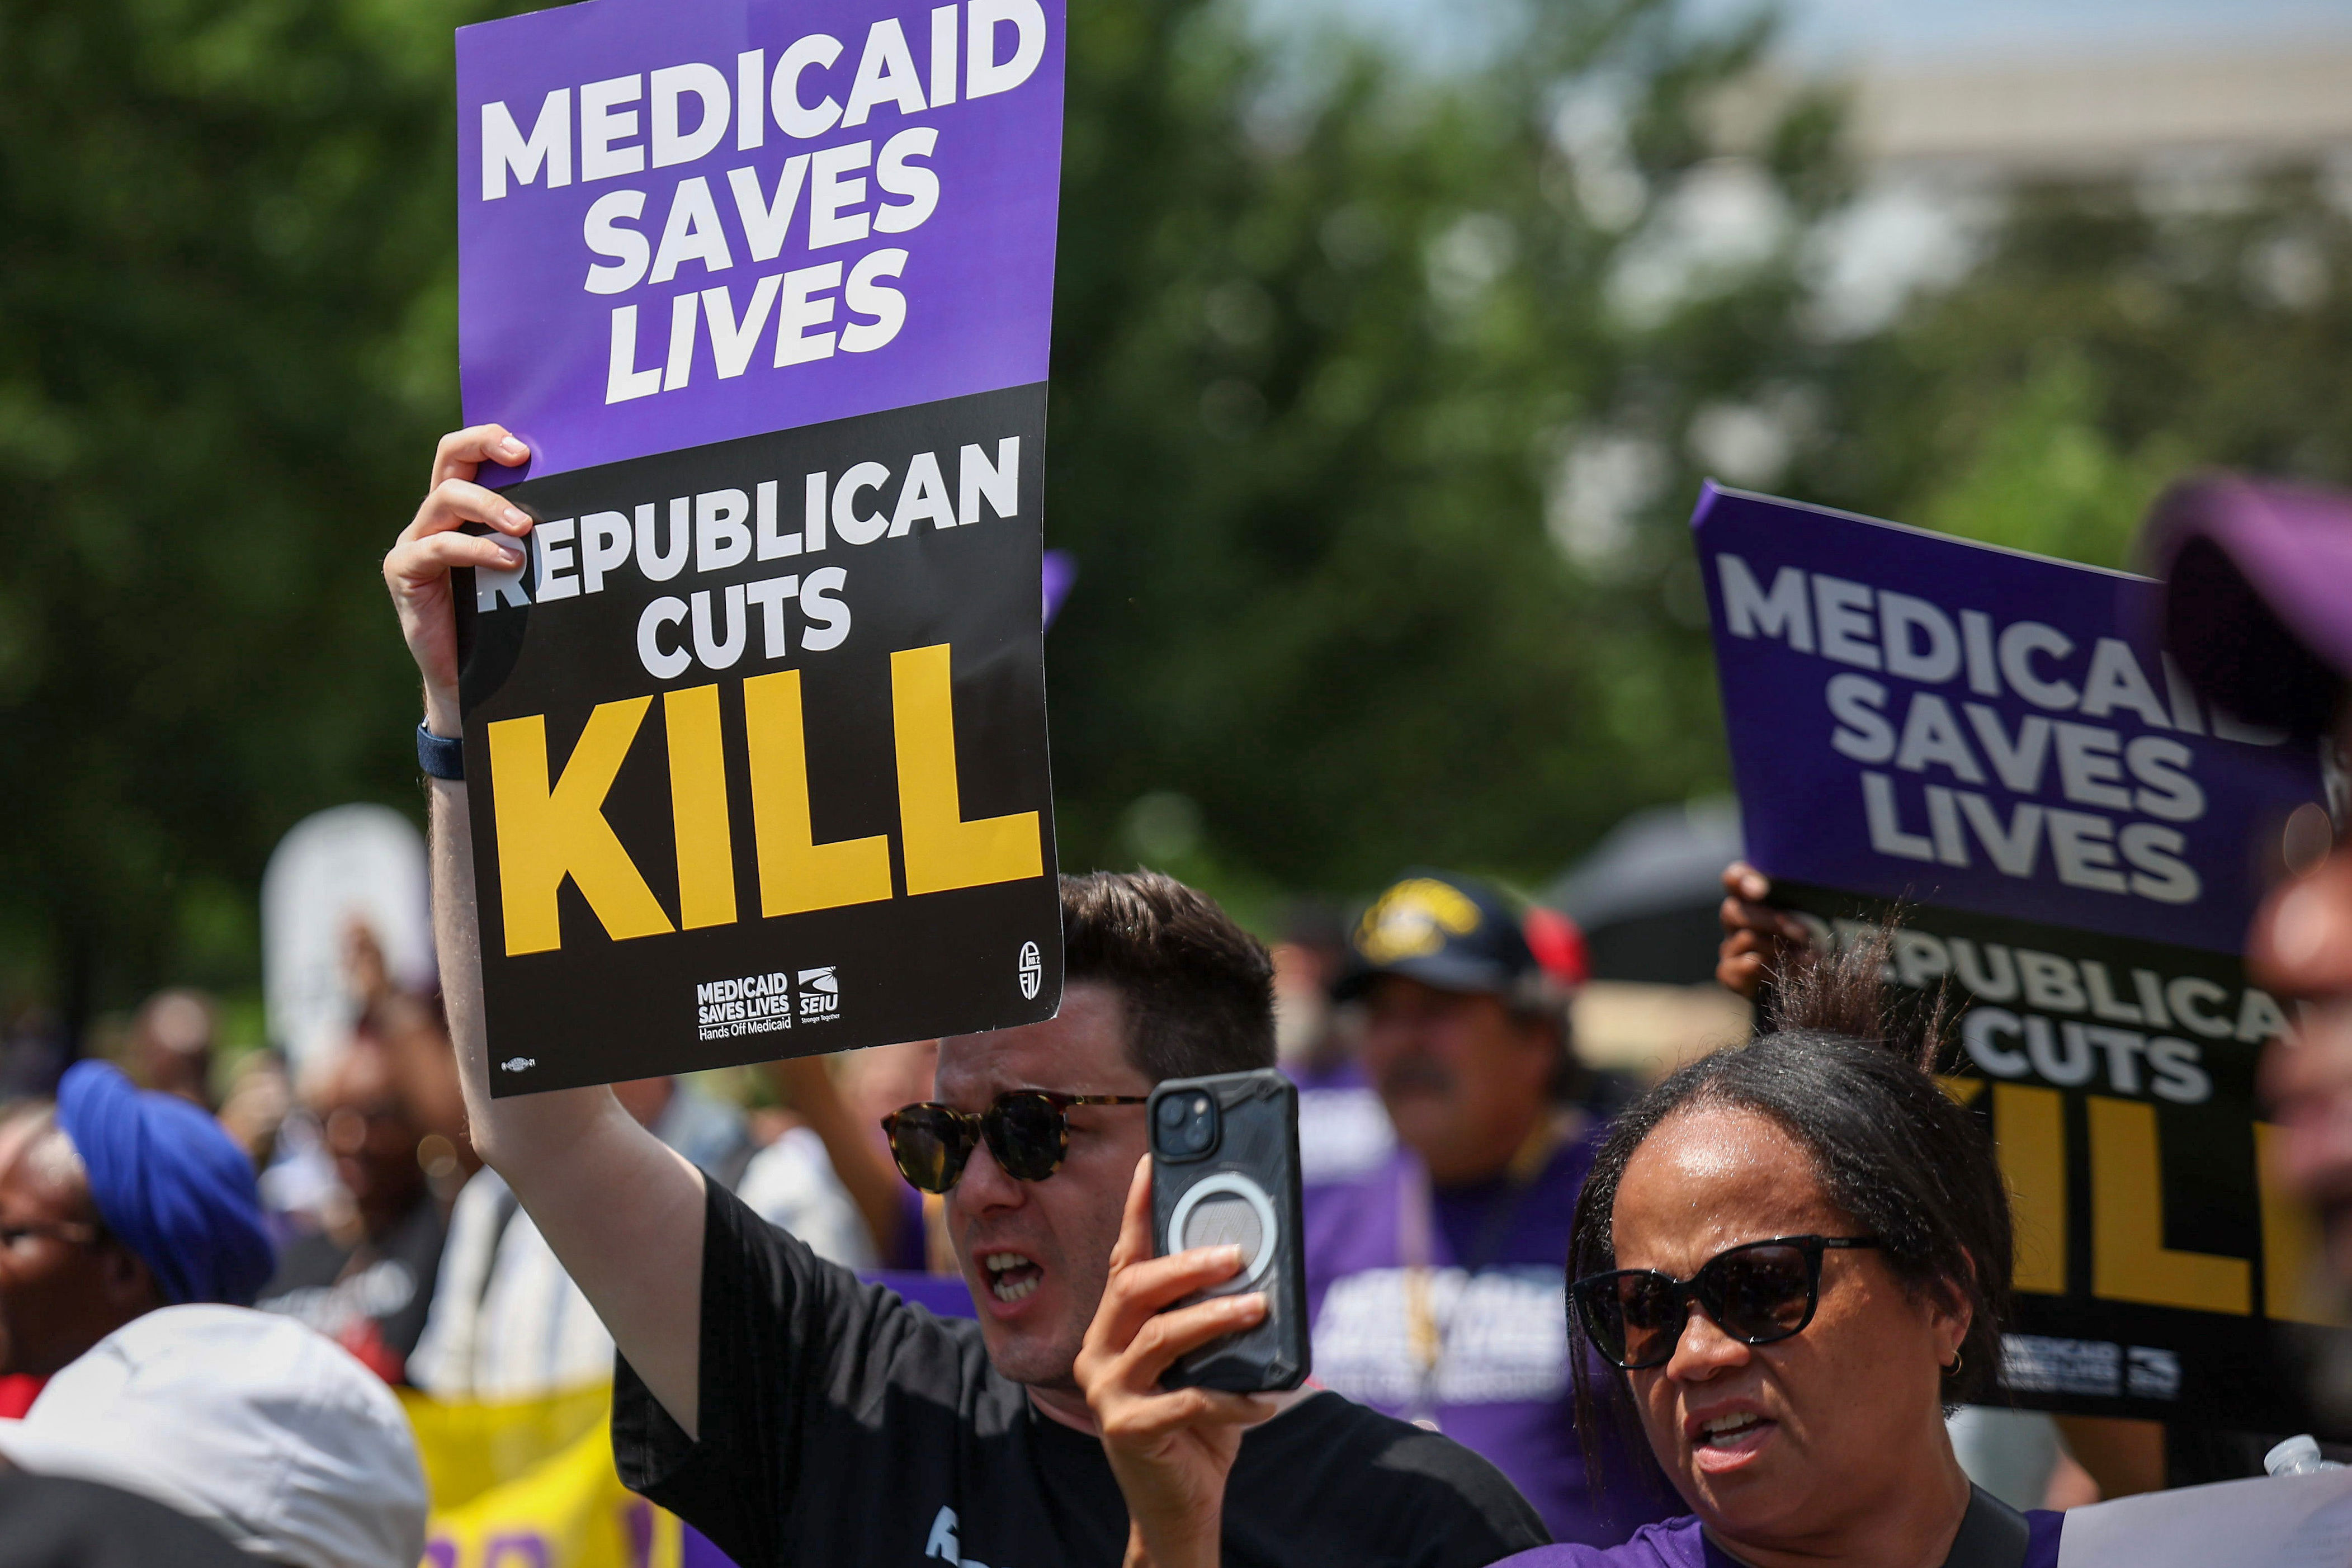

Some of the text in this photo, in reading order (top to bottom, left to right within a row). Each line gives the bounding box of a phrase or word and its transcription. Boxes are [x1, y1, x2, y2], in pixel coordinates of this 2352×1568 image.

[481, 0, 1046, 201] MEDICAID
[583, 126, 940, 295] SAVES
[604, 247, 909, 405] LIVES
[475, 436, 1020, 613] REPUBLICAN
[636, 566, 852, 680] CUTS
[487, 643, 1044, 957] KILL
[1824, 672, 2206, 823] SAVES
[1861, 771, 2203, 906] LIVES
[697, 972, 789, 1006] MEDICAID
[698, 994, 790, 1024] SAVES LIVES
[700, 1016, 792, 1041] Hands Off Medicaid
[799, 994, 838, 1016] SEIU
[801, 1013, 840, 1024] Stronger Together
[1962, 1007, 2213, 1104] CUTS
[1931, 1074, 2352, 1328] ILL
